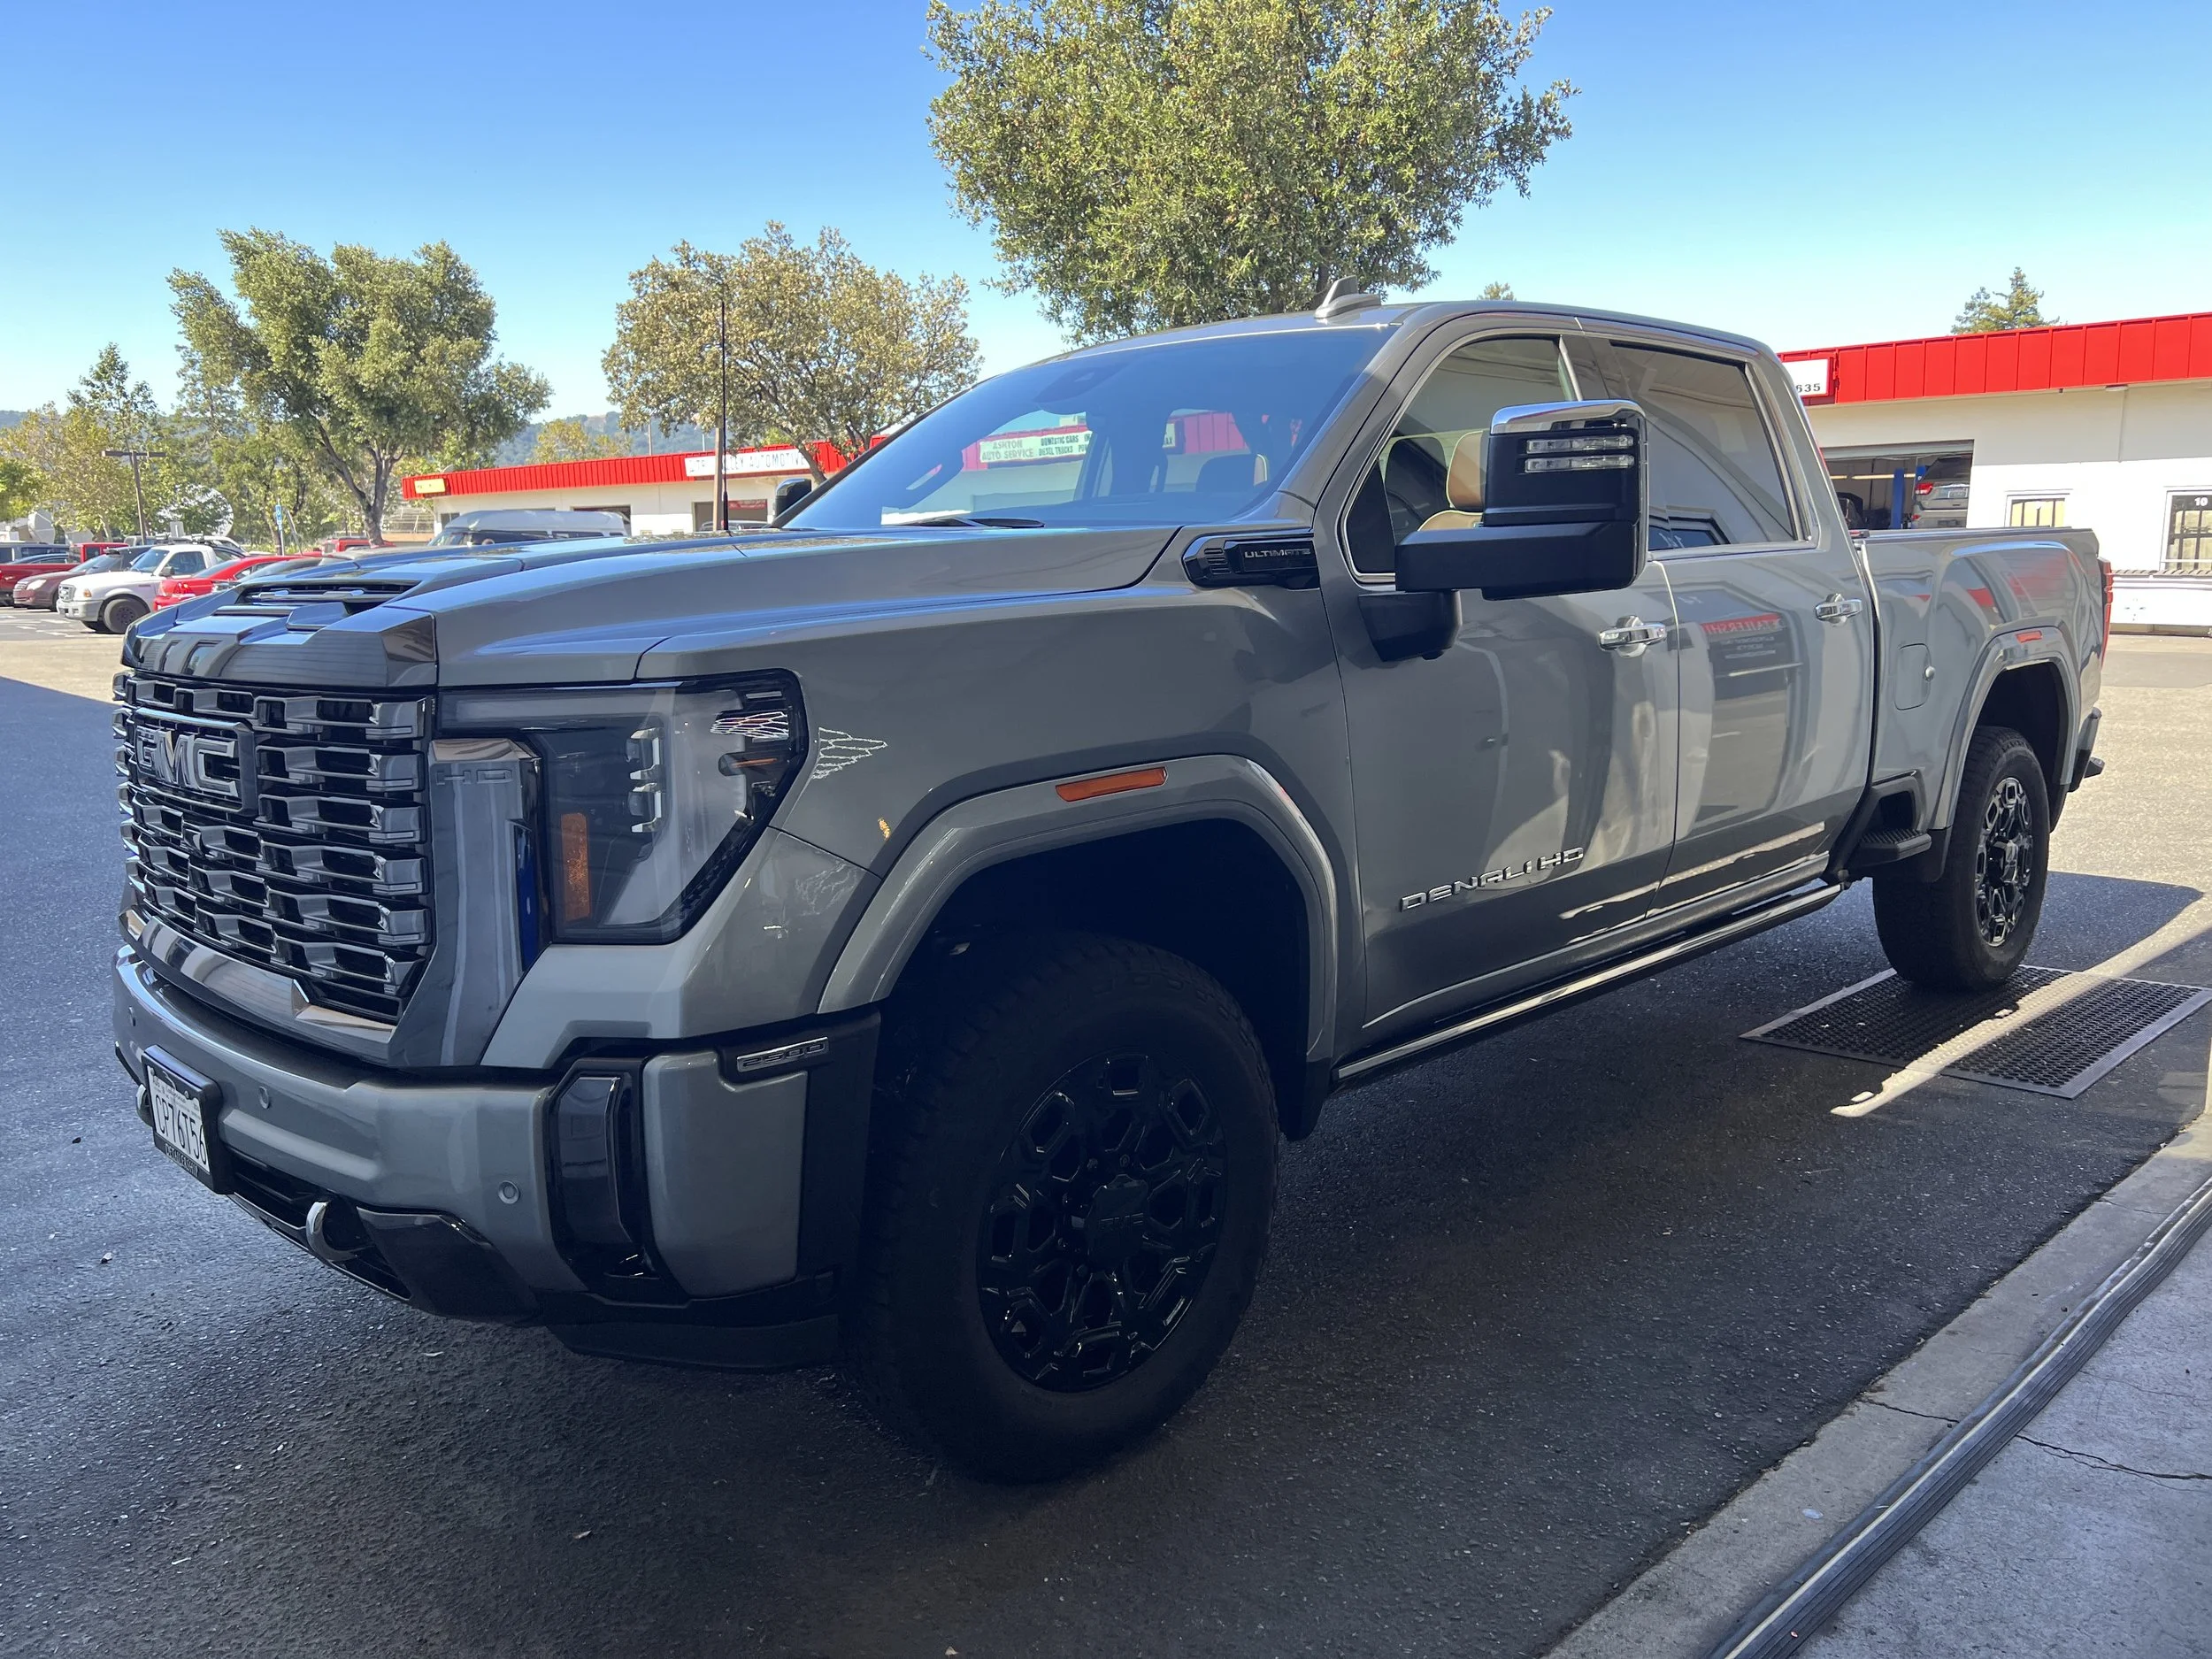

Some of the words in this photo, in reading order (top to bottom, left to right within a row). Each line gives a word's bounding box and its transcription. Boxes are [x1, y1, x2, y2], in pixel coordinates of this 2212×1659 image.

[993, 440, 1023, 449] ASHTON
[982, 451, 1001, 460] AUTO
[1004, 449, 1034, 459] SERVICE
[1039, 447, 1054, 456] DIESEL
[1055, 446, 1073, 455] TRUCKS
[749, 451, 805, 468] AUTOMOTIVE
[2194, 496, 2208, 507] 10
[1244, 548, 1311, 558] ULTIMATE
[135, 725, 239, 797] GMC
[1399, 860, 1532, 912] DENALI
[1537, 847, 1584, 871] HD
[741, 1043, 826, 1067] 2500
